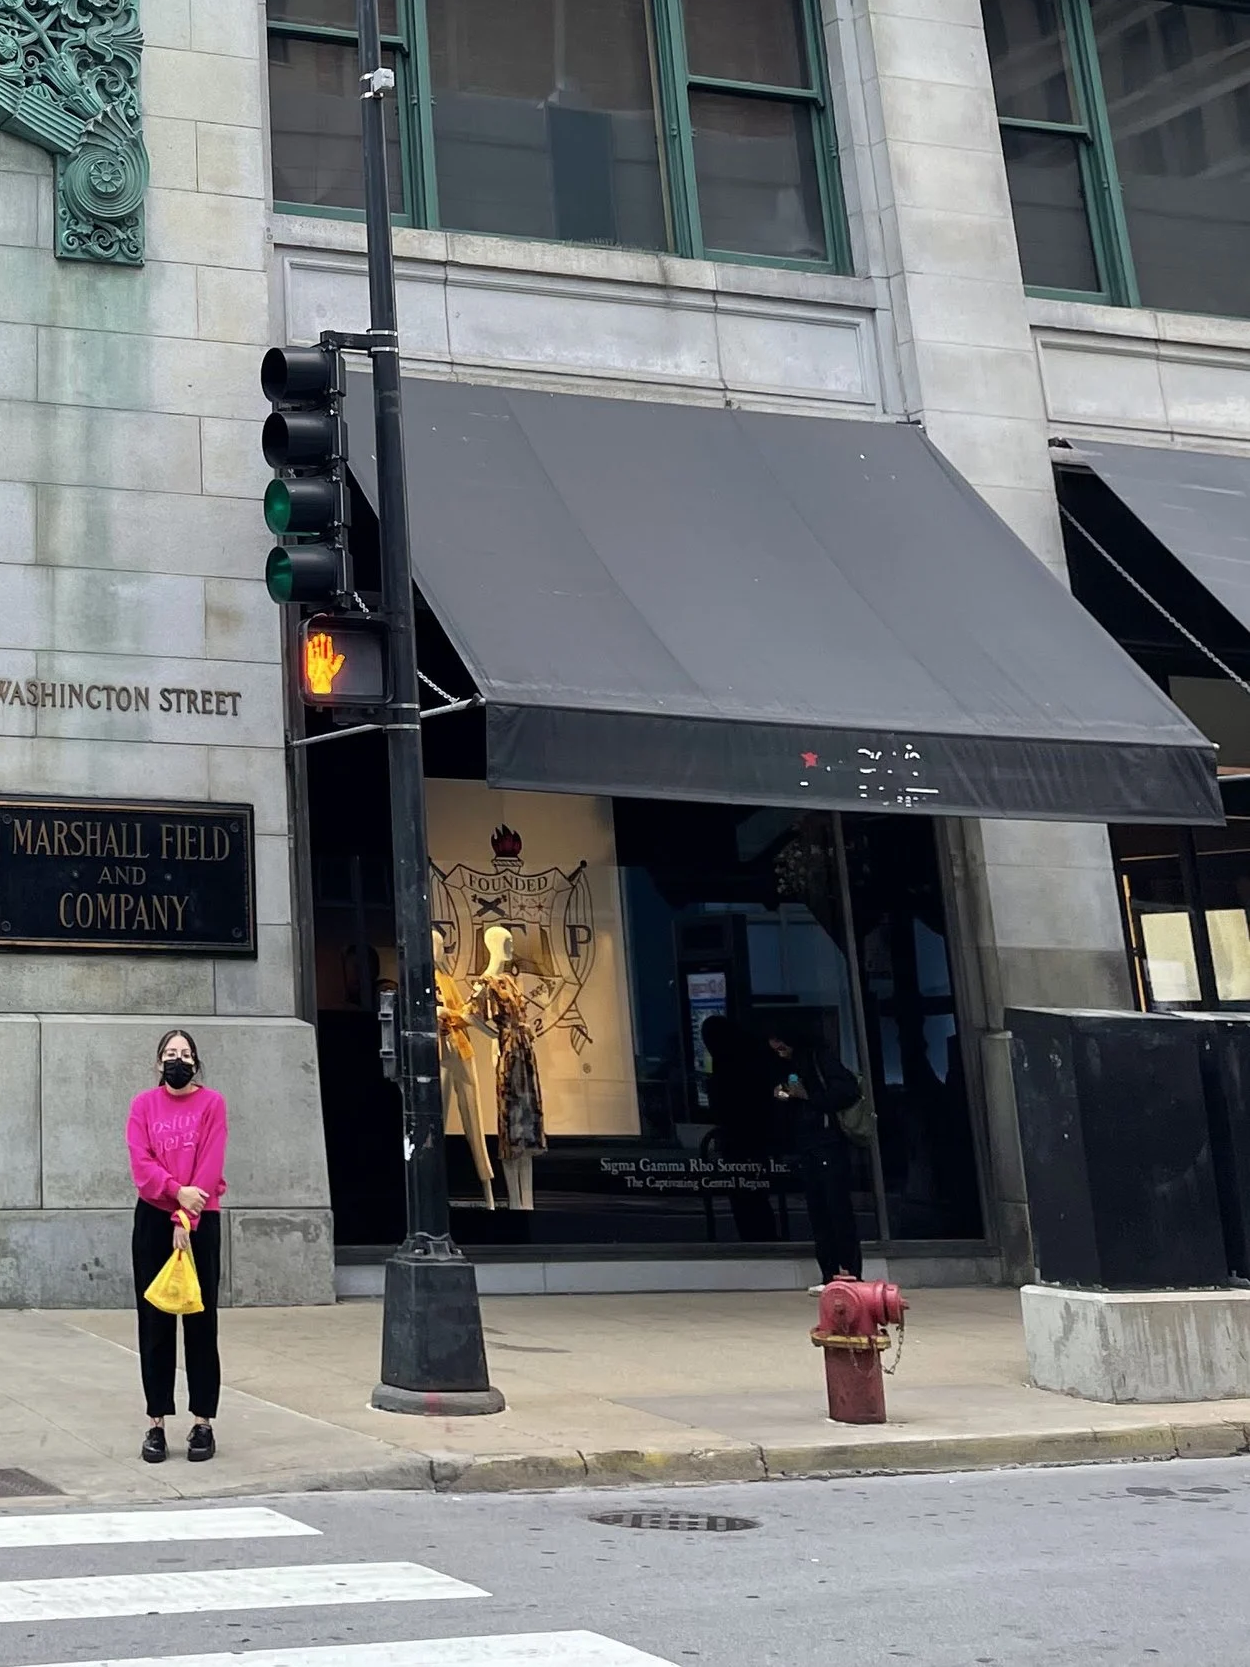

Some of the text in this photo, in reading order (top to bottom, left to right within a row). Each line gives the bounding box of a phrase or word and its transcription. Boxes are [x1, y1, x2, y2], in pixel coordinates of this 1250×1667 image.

[159, 687, 242, 717] STREET
[12, 818, 230, 862] MARSHALL FIELD
[97, 865, 147, 886] AND
[468, 873, 548, 892] FOUNDED
[59, 891, 190, 932] COMPANY
[600, 1158, 636, 1175] Sigma
[639, 1158, 686, 1173] Gamma
[689, 1158, 714, 1173] Rho
[770, 1158, 791, 1173] Inc.
[624, 1176, 644, 1189] The
[701, 1176, 736, 1189] Central
[739, 1177, 770, 1192] Region
